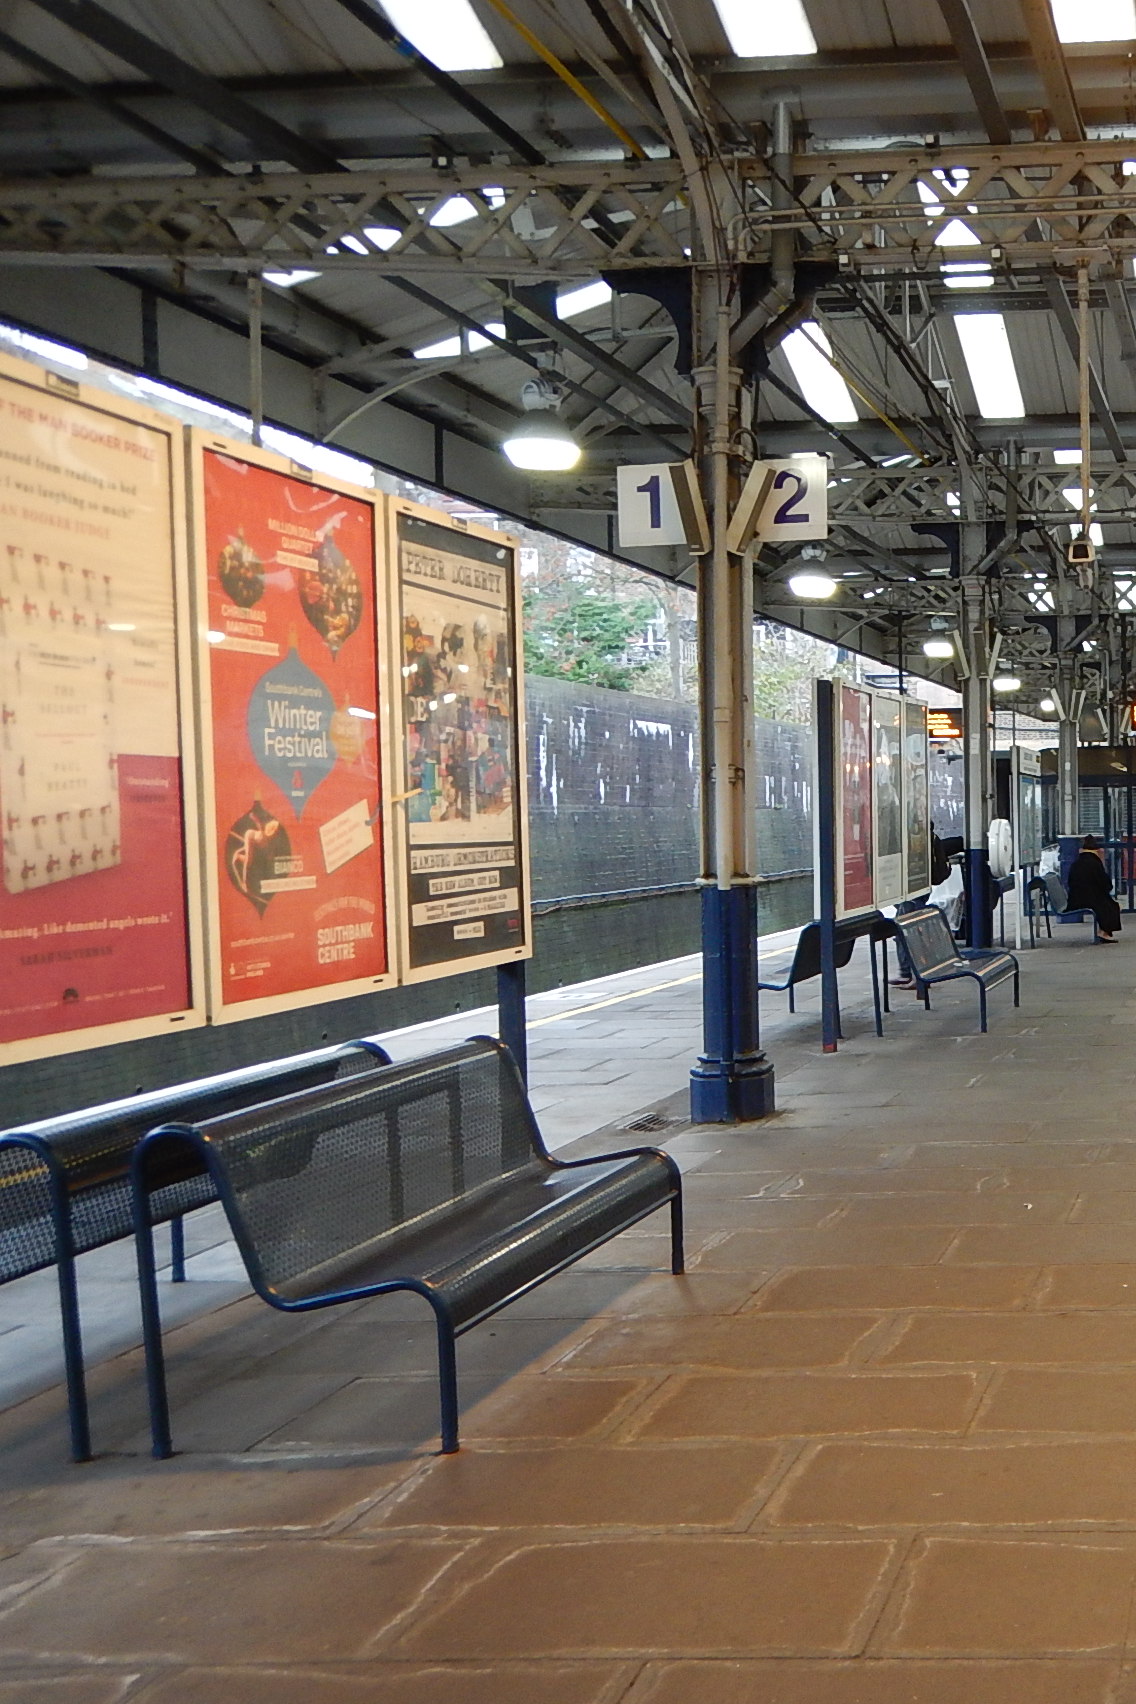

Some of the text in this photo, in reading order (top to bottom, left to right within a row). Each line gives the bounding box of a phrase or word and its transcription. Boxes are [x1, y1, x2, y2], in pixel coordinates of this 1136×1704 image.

[71, 422, 121, 449] BOOKER
[636, 475, 662, 528] 1
[773, 467, 810, 524] 2
[405, 551, 502, 594] PETER DOHERTY
[222, 604, 267, 623] CHRISTMAS
[226, 620, 264, 637] MARKETS
[268, 700, 322, 731] Winter
[264, 728, 328, 758] Festival
[274, 860, 304, 875] BIANCO
[318, 922, 374, 946] SOUTHBANK
[318, 942, 356, 965] CENTRE
